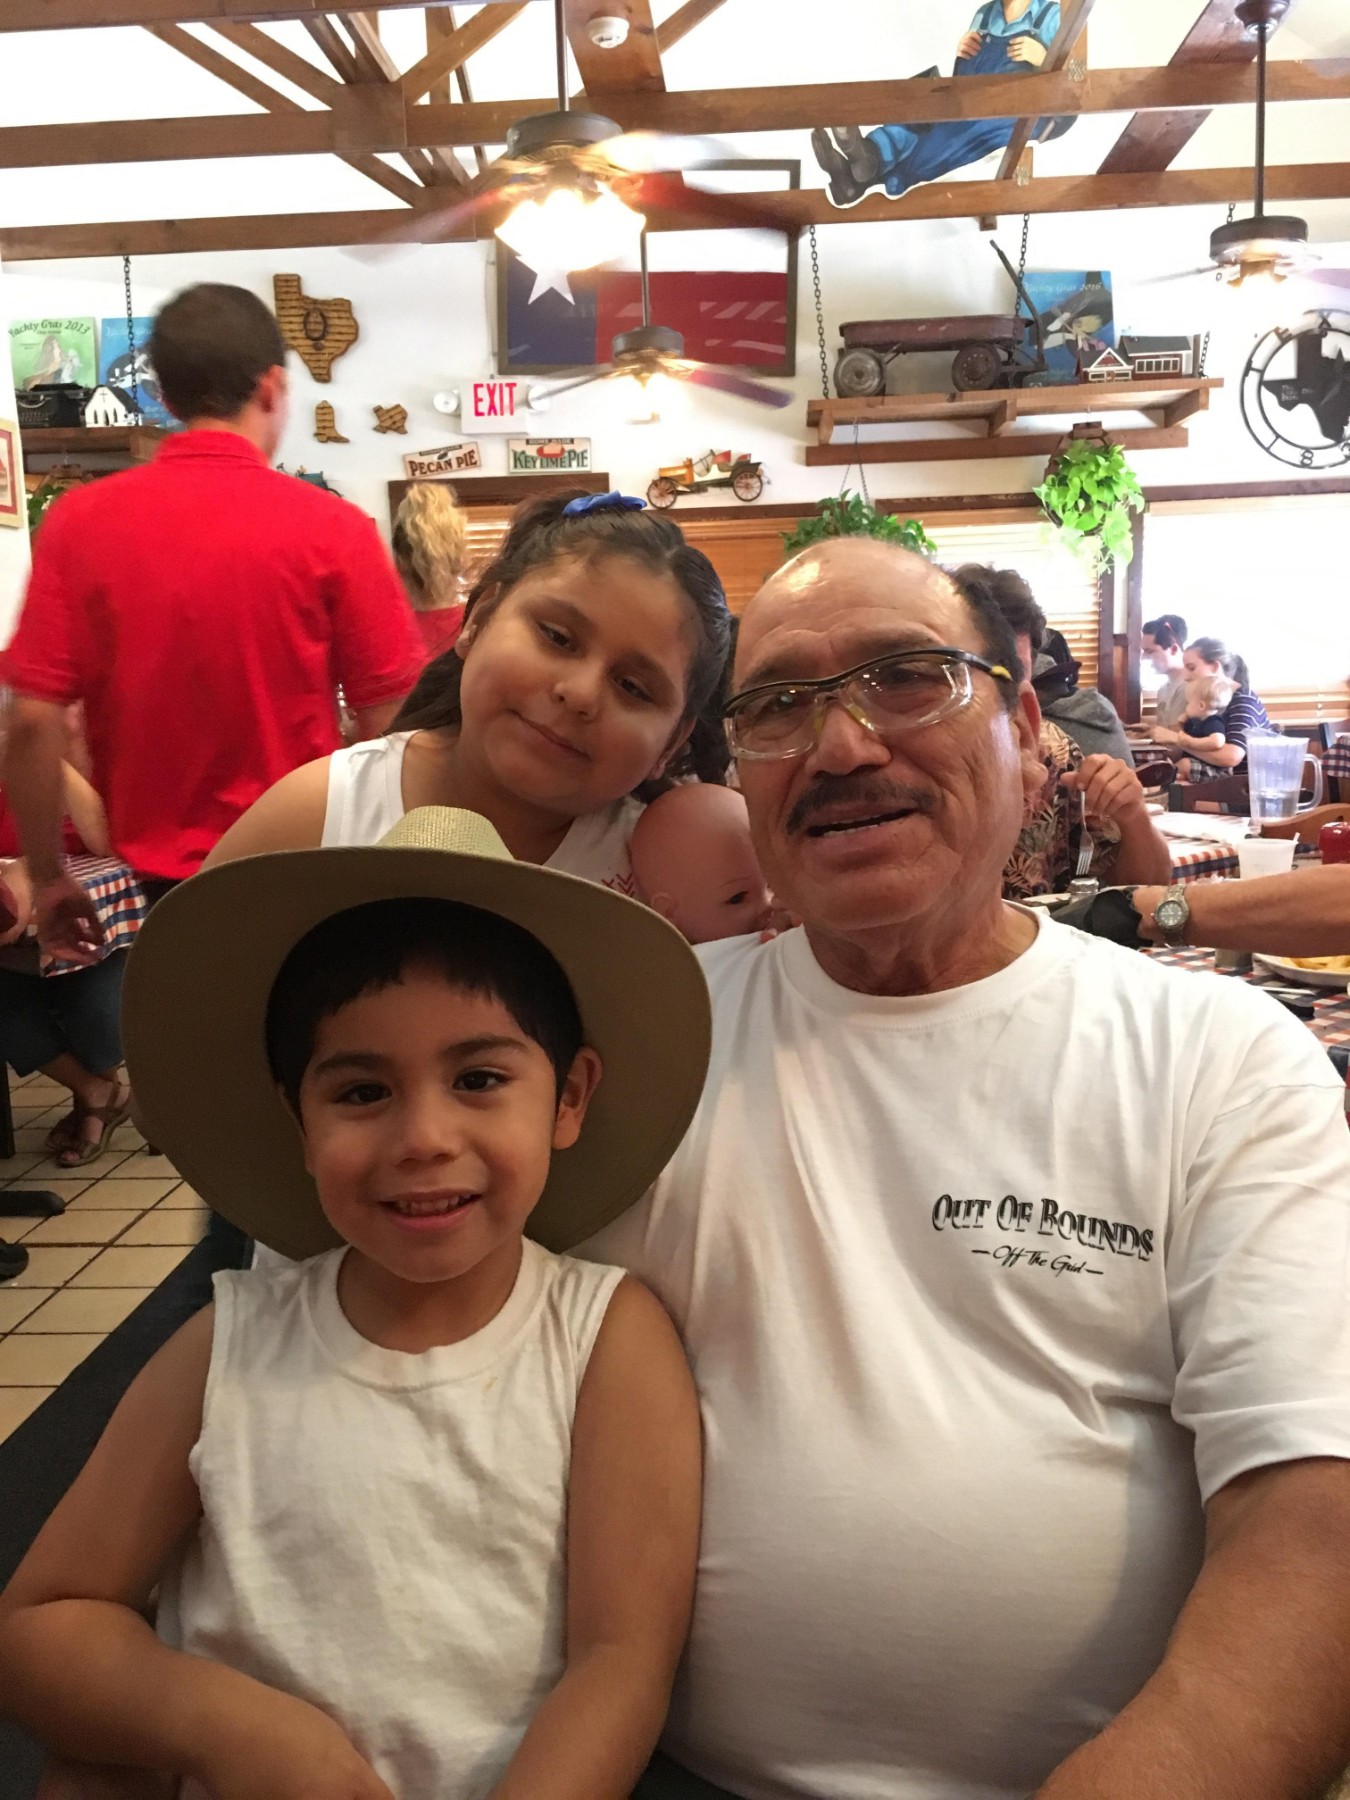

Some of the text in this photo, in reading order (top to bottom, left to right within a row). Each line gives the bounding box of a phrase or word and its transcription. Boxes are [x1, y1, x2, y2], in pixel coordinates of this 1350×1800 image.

[8, 321, 39, 338] Yachty
[41, 319, 62, 329] Gras
[64, 320, 91, 335] 2013
[473, 382, 517, 417] EXIT
[408, 457, 453, 477] PECAN
[457, 449, 478, 468] PIE
[511, 449, 588, 469] KEY LIME PIE
[932, 1194, 1154, 1262] OUT OF BOUNDS
[993, 1245, 1026, 1268] Off
[1051, 1254, 1088, 1278] Grid
